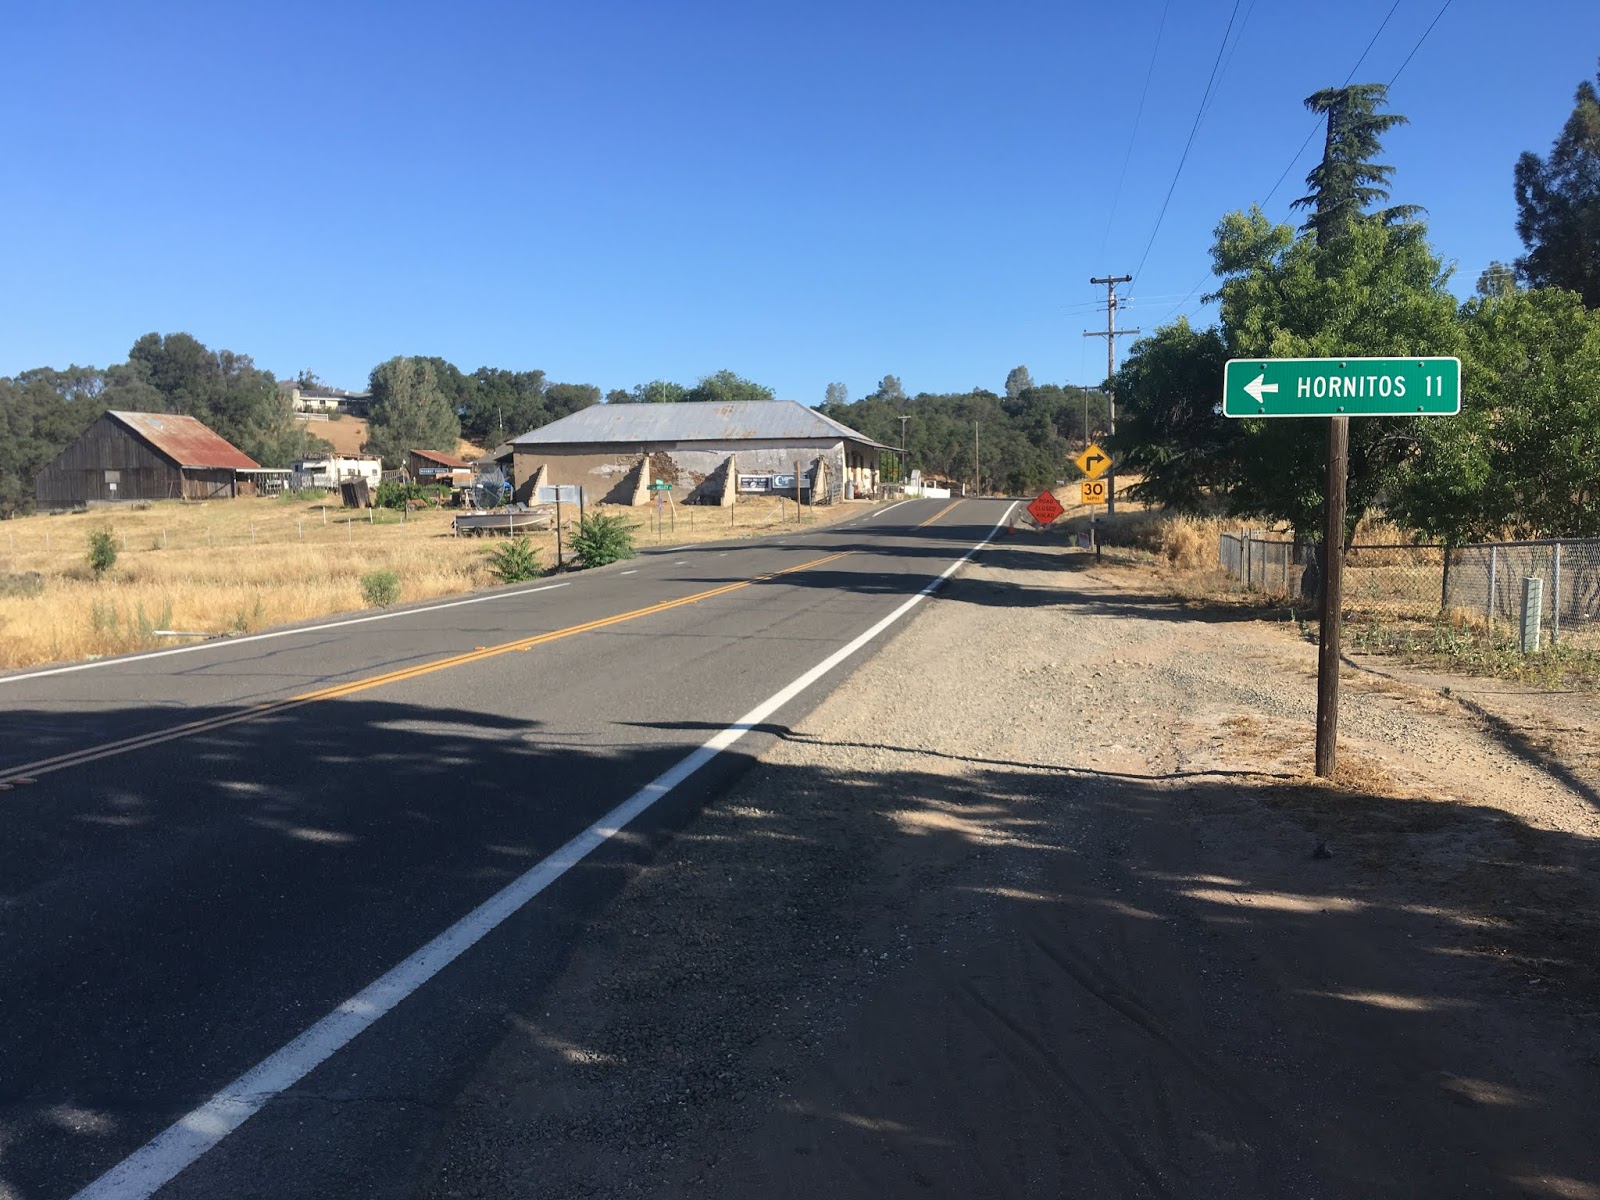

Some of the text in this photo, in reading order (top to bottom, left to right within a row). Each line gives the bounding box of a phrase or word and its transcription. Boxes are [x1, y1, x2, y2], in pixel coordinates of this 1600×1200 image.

[1297, 375, 1442, 398] HORNITOS 11
[1084, 483, 1103, 495] 30
